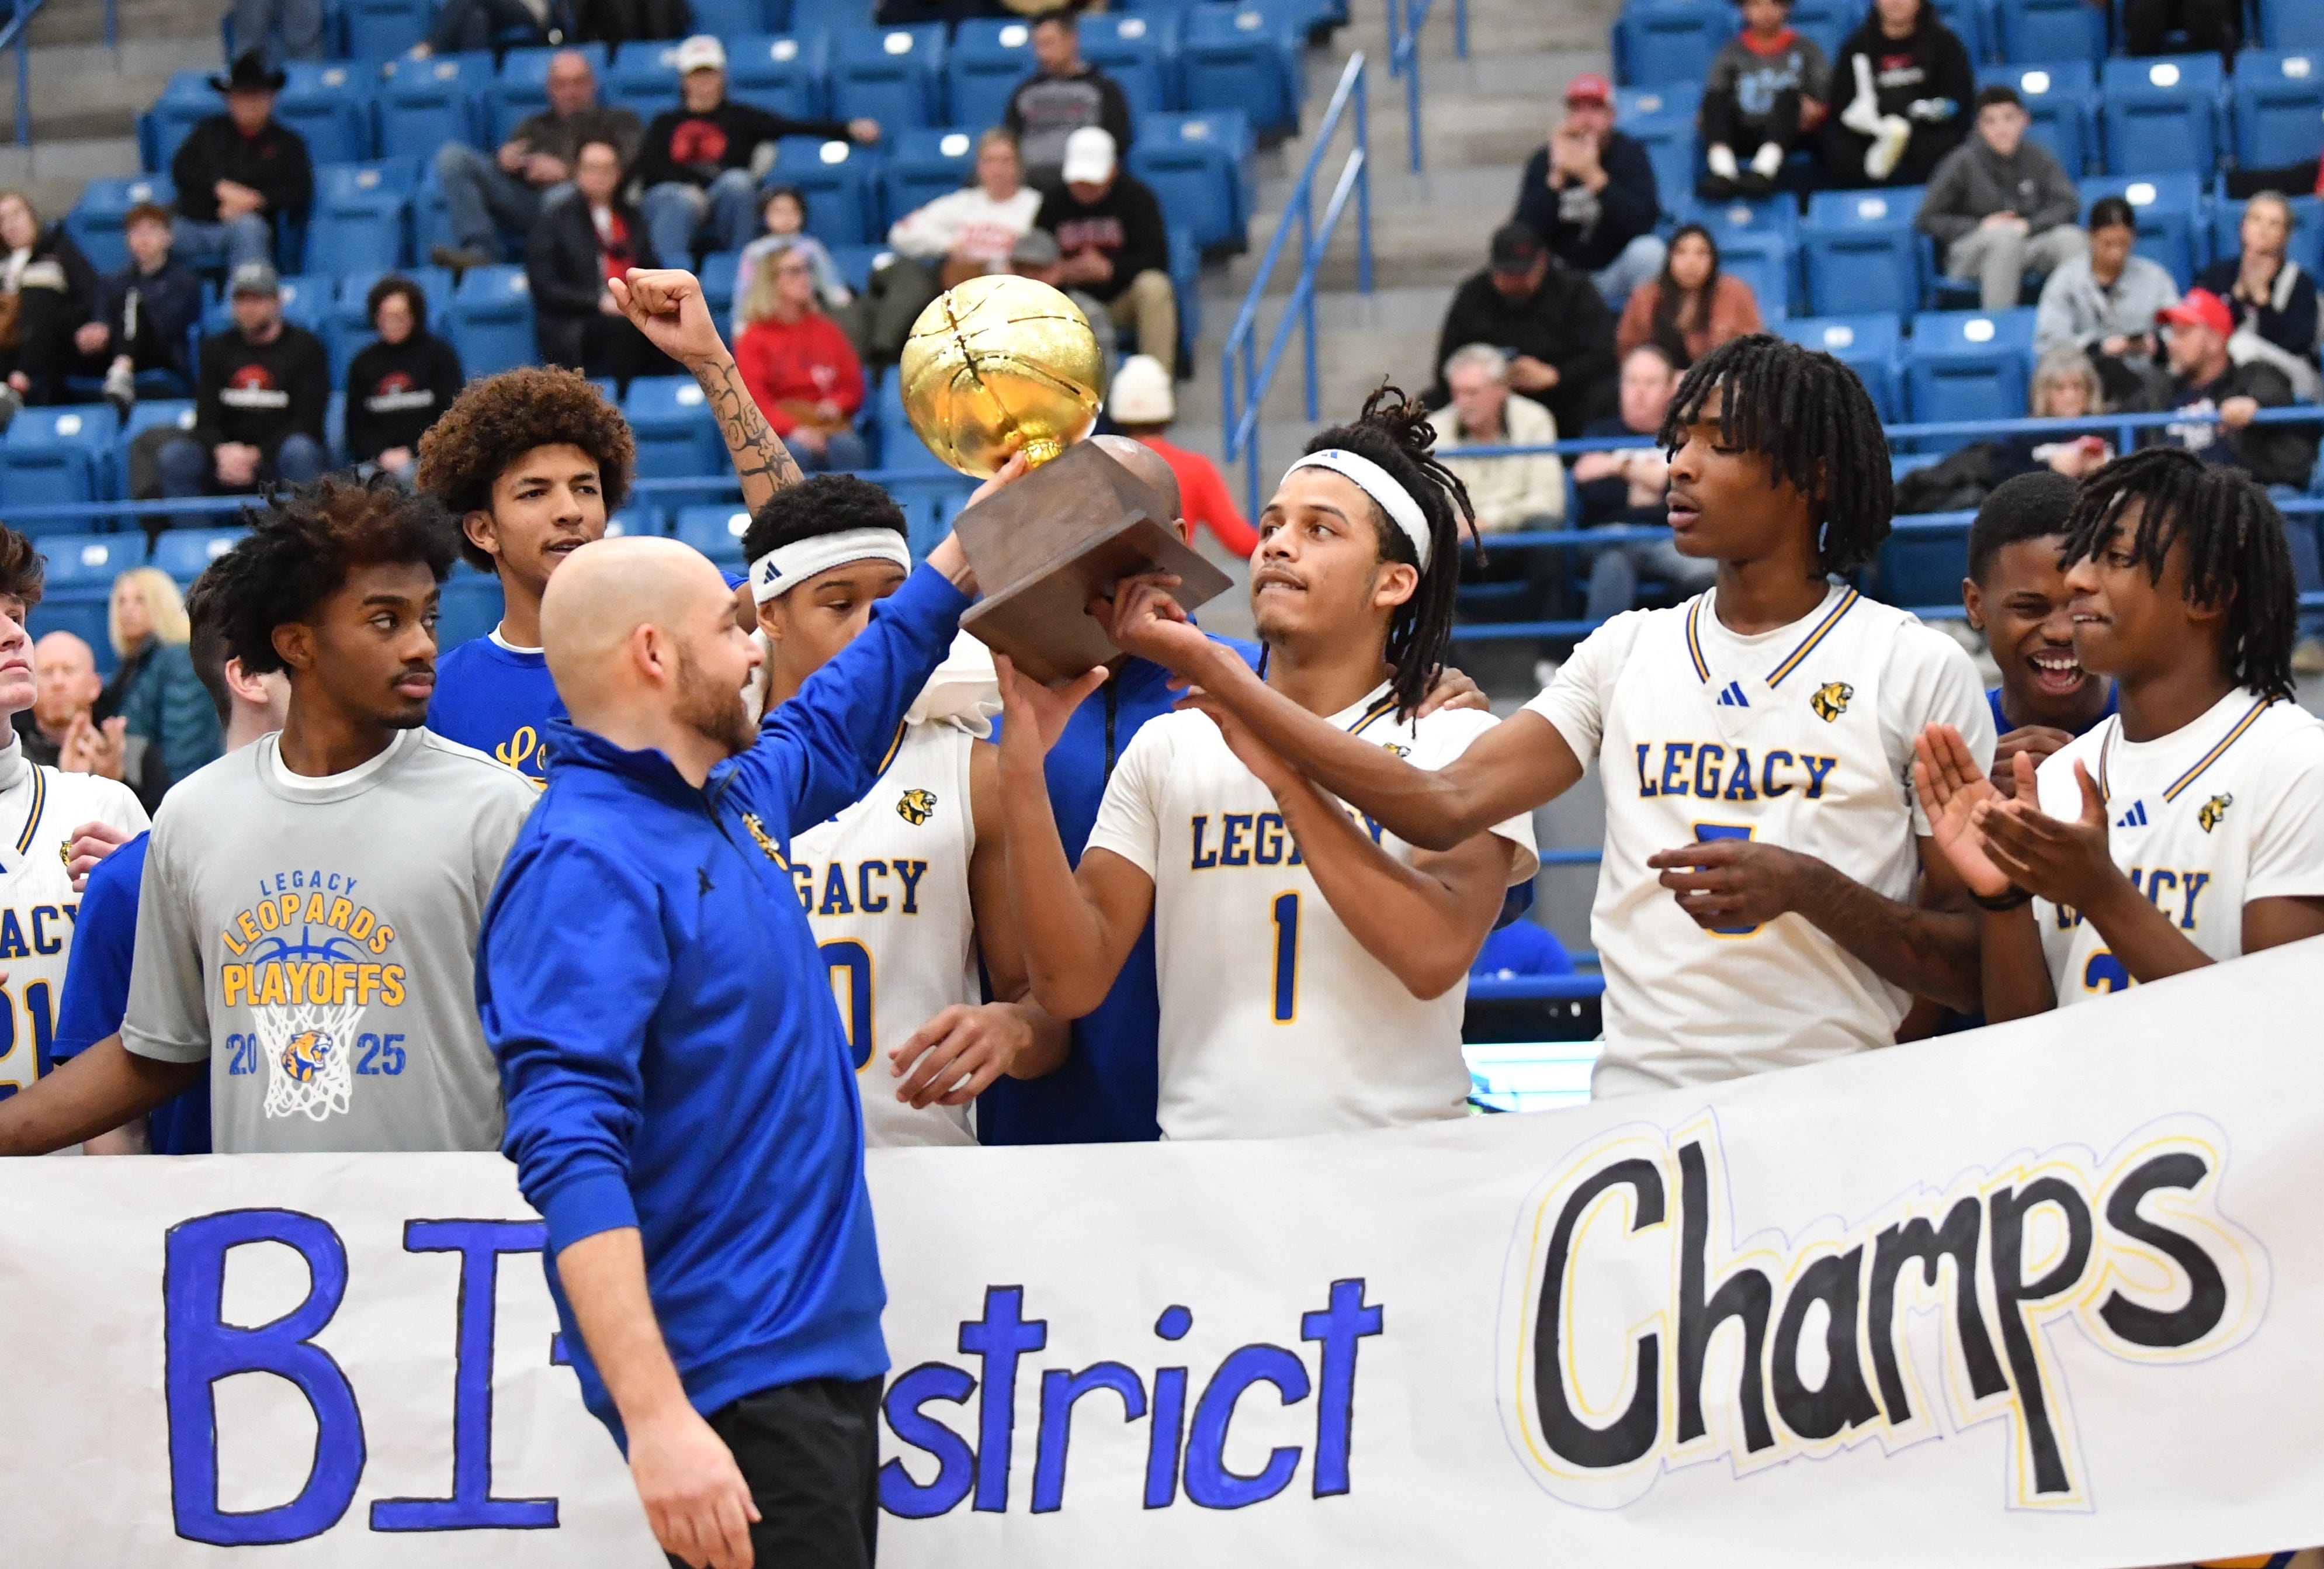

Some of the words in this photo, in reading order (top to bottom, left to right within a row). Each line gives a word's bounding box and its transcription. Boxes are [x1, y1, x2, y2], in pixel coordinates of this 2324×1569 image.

[1635, 741, 1839, 801] LEGACY
[261, 870, 357, 896] LEGACY
[223, 892, 395, 957] LEOPARDS
[221, 962, 407, 1007] PLAYOFFS
[1270, 889, 1302, 1026] 1
[226, 1033, 257, 1075] 20
[356, 1033, 407, 1075] 25
[1533, 1141, 2227, 1495] Champs
